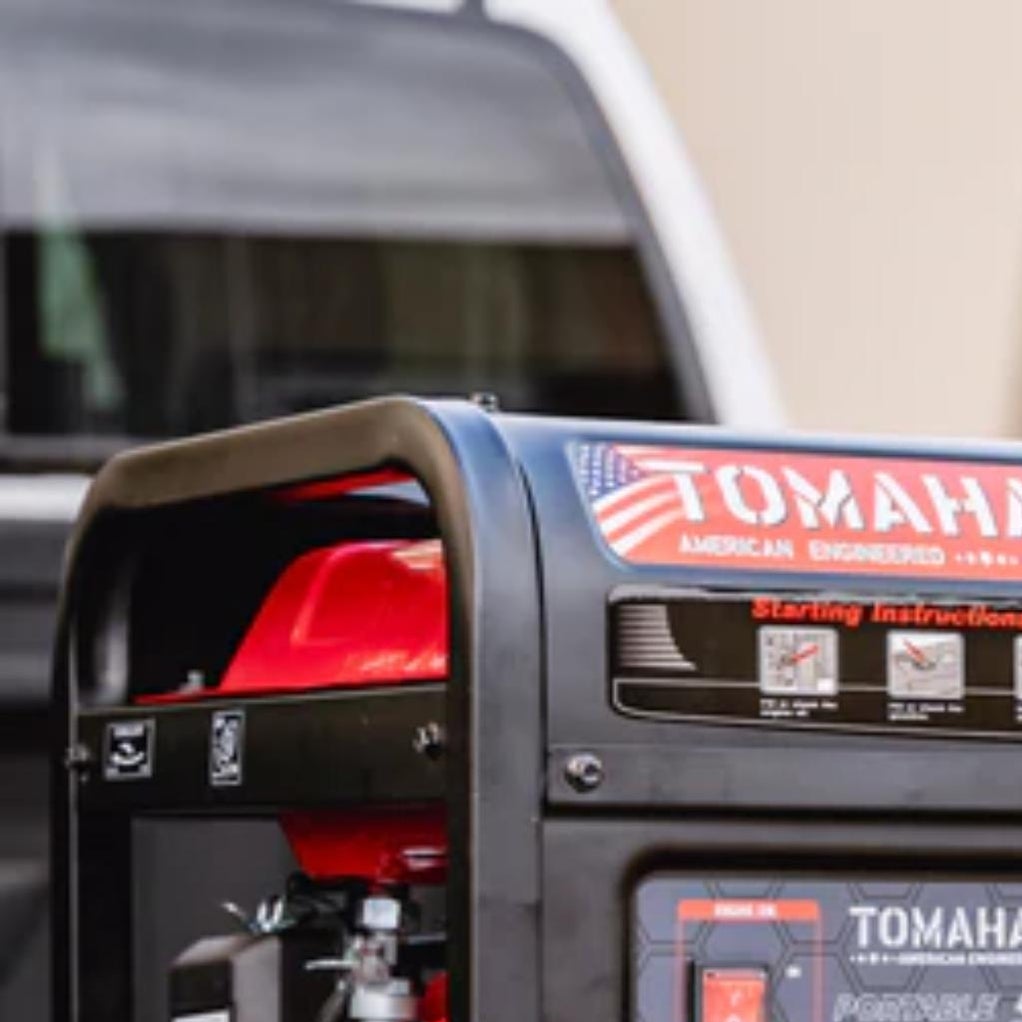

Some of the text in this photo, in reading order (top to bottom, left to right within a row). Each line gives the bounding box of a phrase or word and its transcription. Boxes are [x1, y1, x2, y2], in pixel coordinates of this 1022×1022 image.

[679, 535, 946, 566] AMERICAN ENGINEERED
[752, 599, 863, 626] Starting
